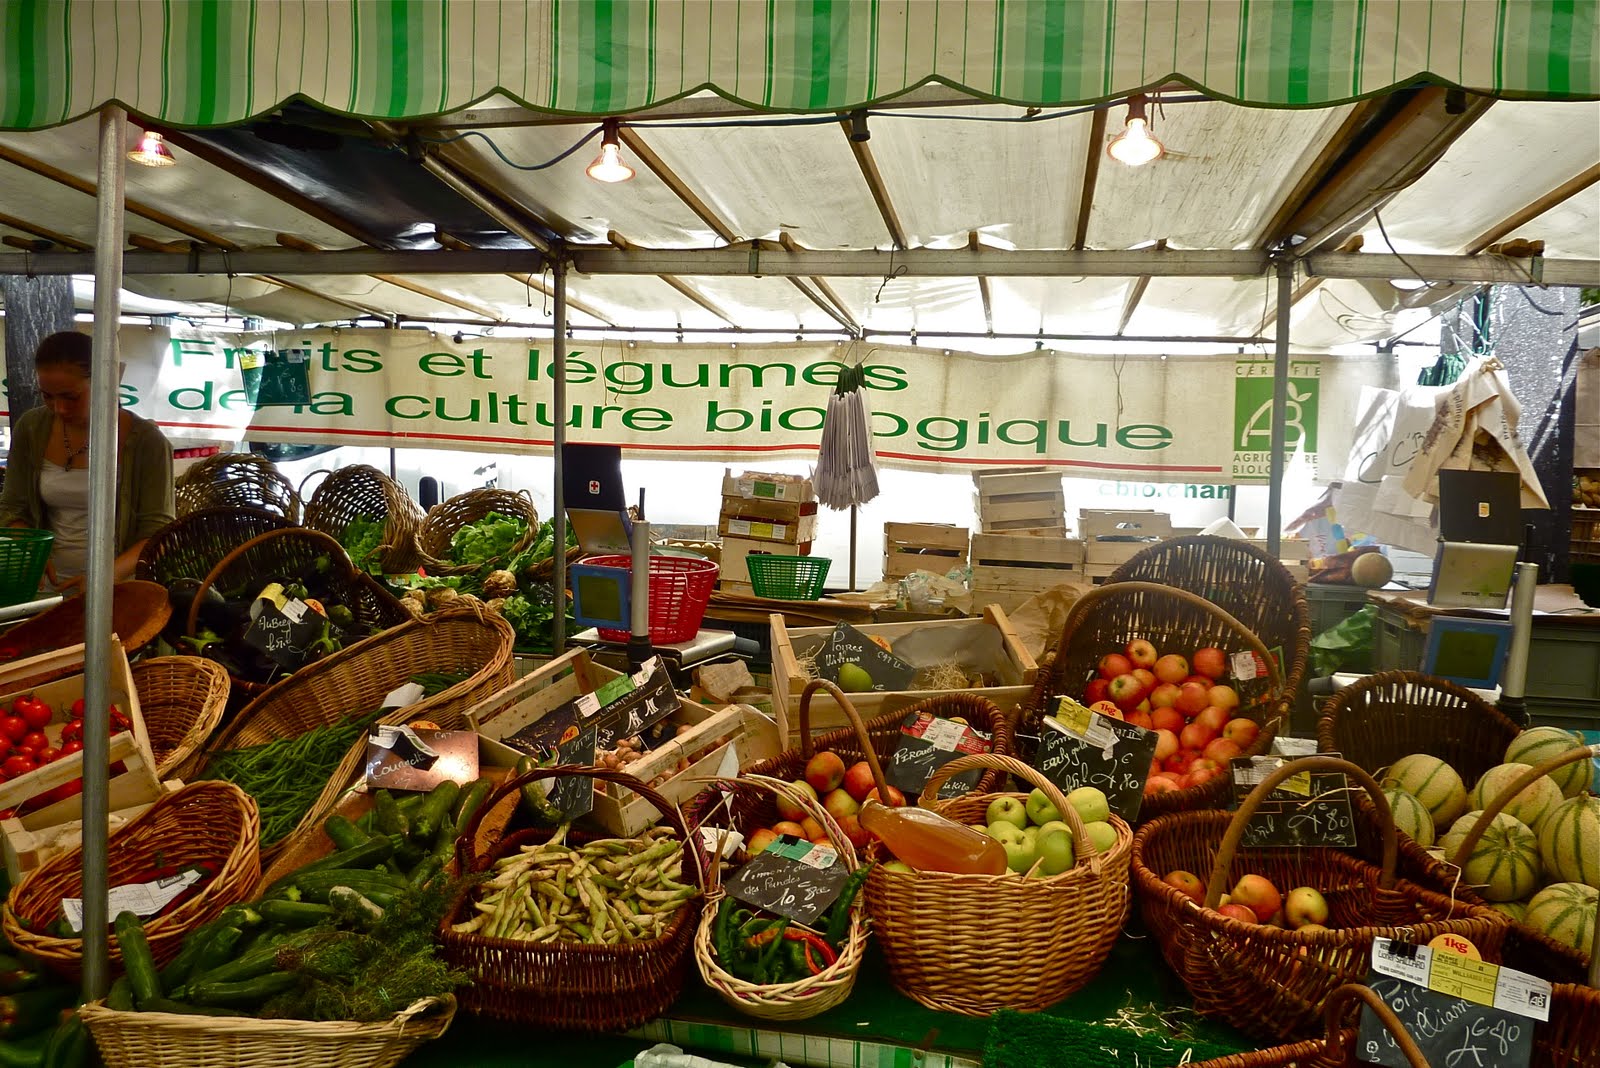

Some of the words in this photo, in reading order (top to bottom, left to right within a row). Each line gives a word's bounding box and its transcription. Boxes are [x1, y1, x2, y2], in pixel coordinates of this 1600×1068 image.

[170, 338, 383, 374] Frits
[419, 347, 493, 380] et
[527, 348, 909, 395] légumes
[1236, 366, 1321, 376] CERFIE
[384, 390, 673, 433] culture
[706, 400, 1174, 453] bioogique
[1100, 703, 1117, 717] 1kg
[1443, 937, 1469, 954] 1kg
